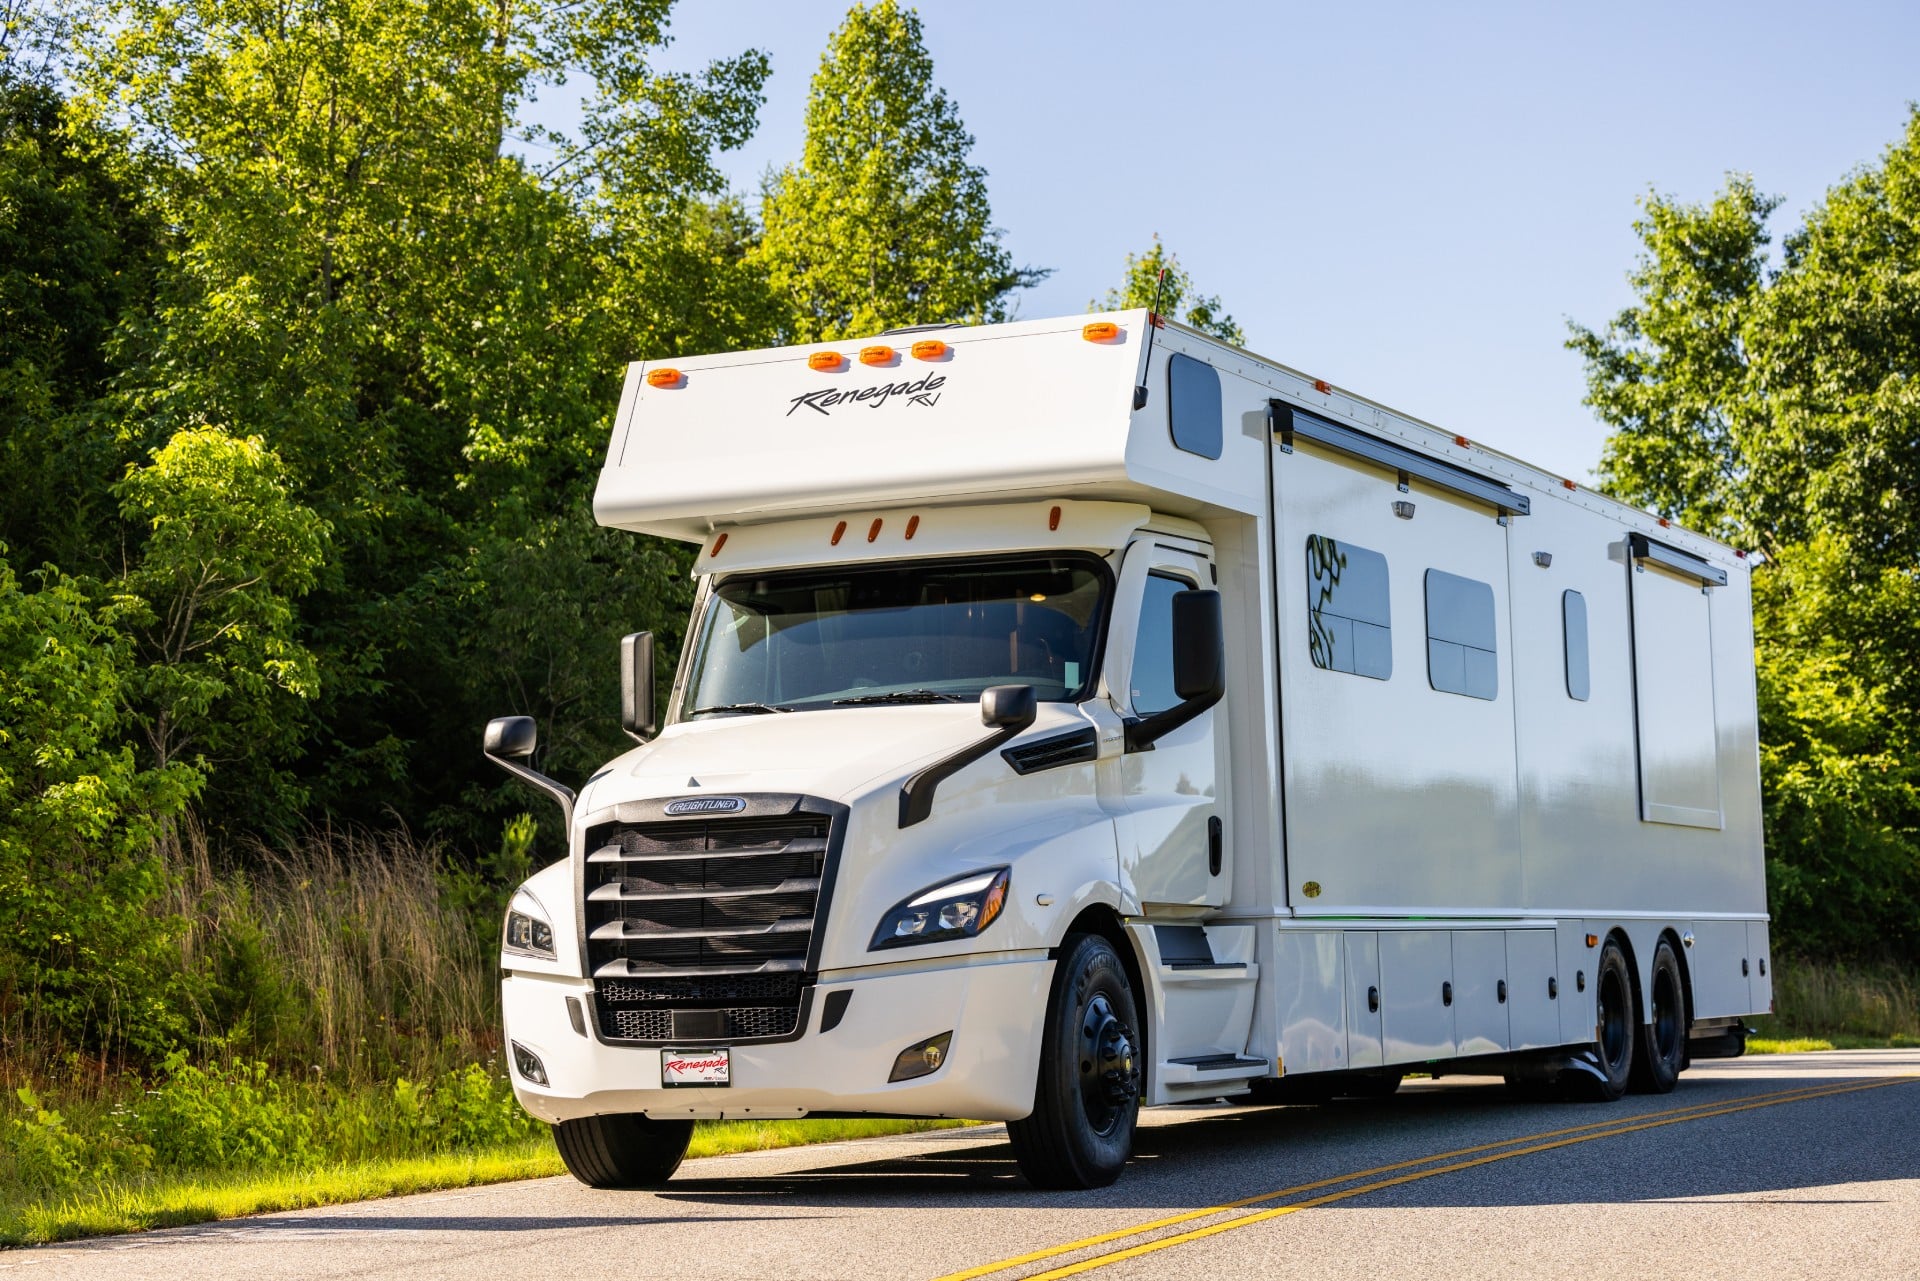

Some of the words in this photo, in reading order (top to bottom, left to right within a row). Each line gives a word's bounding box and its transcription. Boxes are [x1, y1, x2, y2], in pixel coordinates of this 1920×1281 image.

[786, 371, 947, 416] Renegade
[906, 392, 942, 407] RV
[671, 800, 736, 811] FREIGHTLINER
[665, 1056, 729, 1074] Renegade
